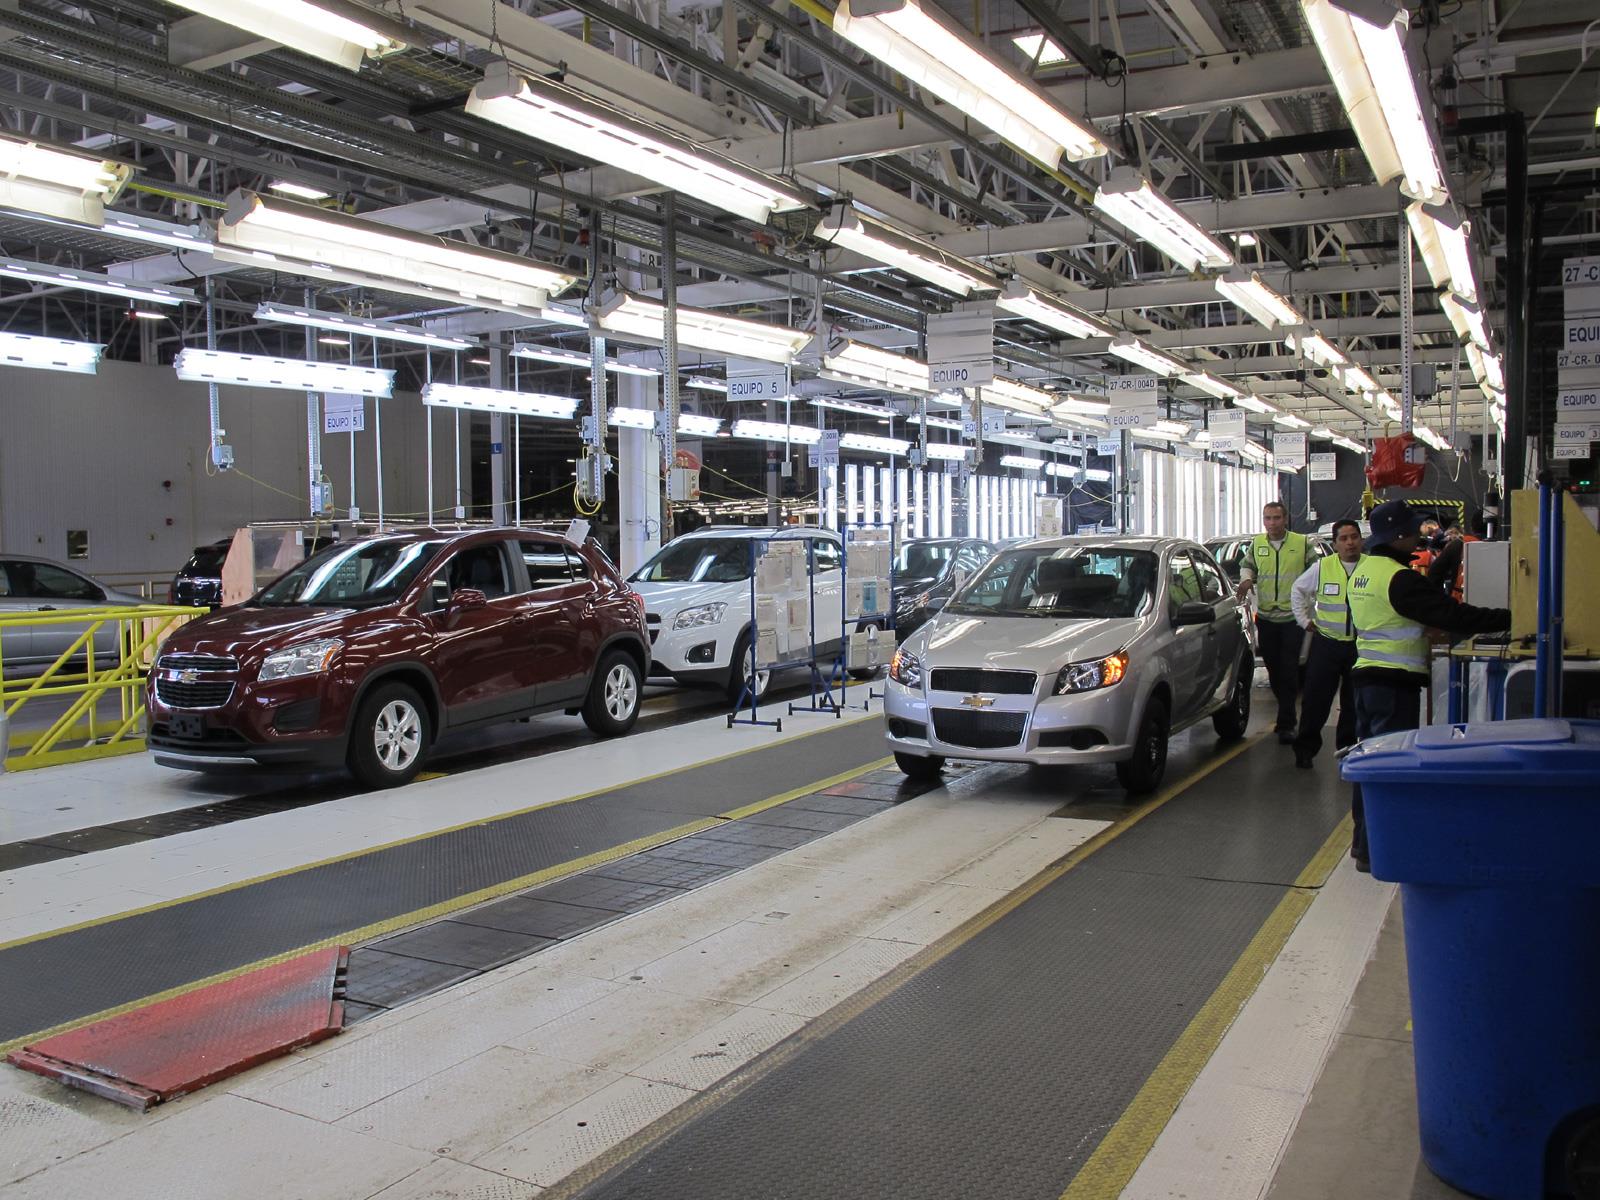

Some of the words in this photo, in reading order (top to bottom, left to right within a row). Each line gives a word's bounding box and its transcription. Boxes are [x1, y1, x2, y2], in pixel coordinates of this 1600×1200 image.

[1565, 267, 1580, 282] 27
[1584, 265, 1600, 281] -C
[1569, 325, 1600, 343] EQUI
[1559, 356, 1569, 366] 27
[933, 368, 968, 383] EQUIPO
[731, 382, 763, 395] EQUIPO
[771, 381, 778, 394] 5
[1563, 394, 1597, 406] EQUIPO
[327, 417, 349, 428] EQUIPO
[352, 416, 358, 426] 5
[993, 421, 999, 431] 4
[1113, 415, 1140, 425] EQUIPO
[1560, 430, 1585, 438] EQUIPO
